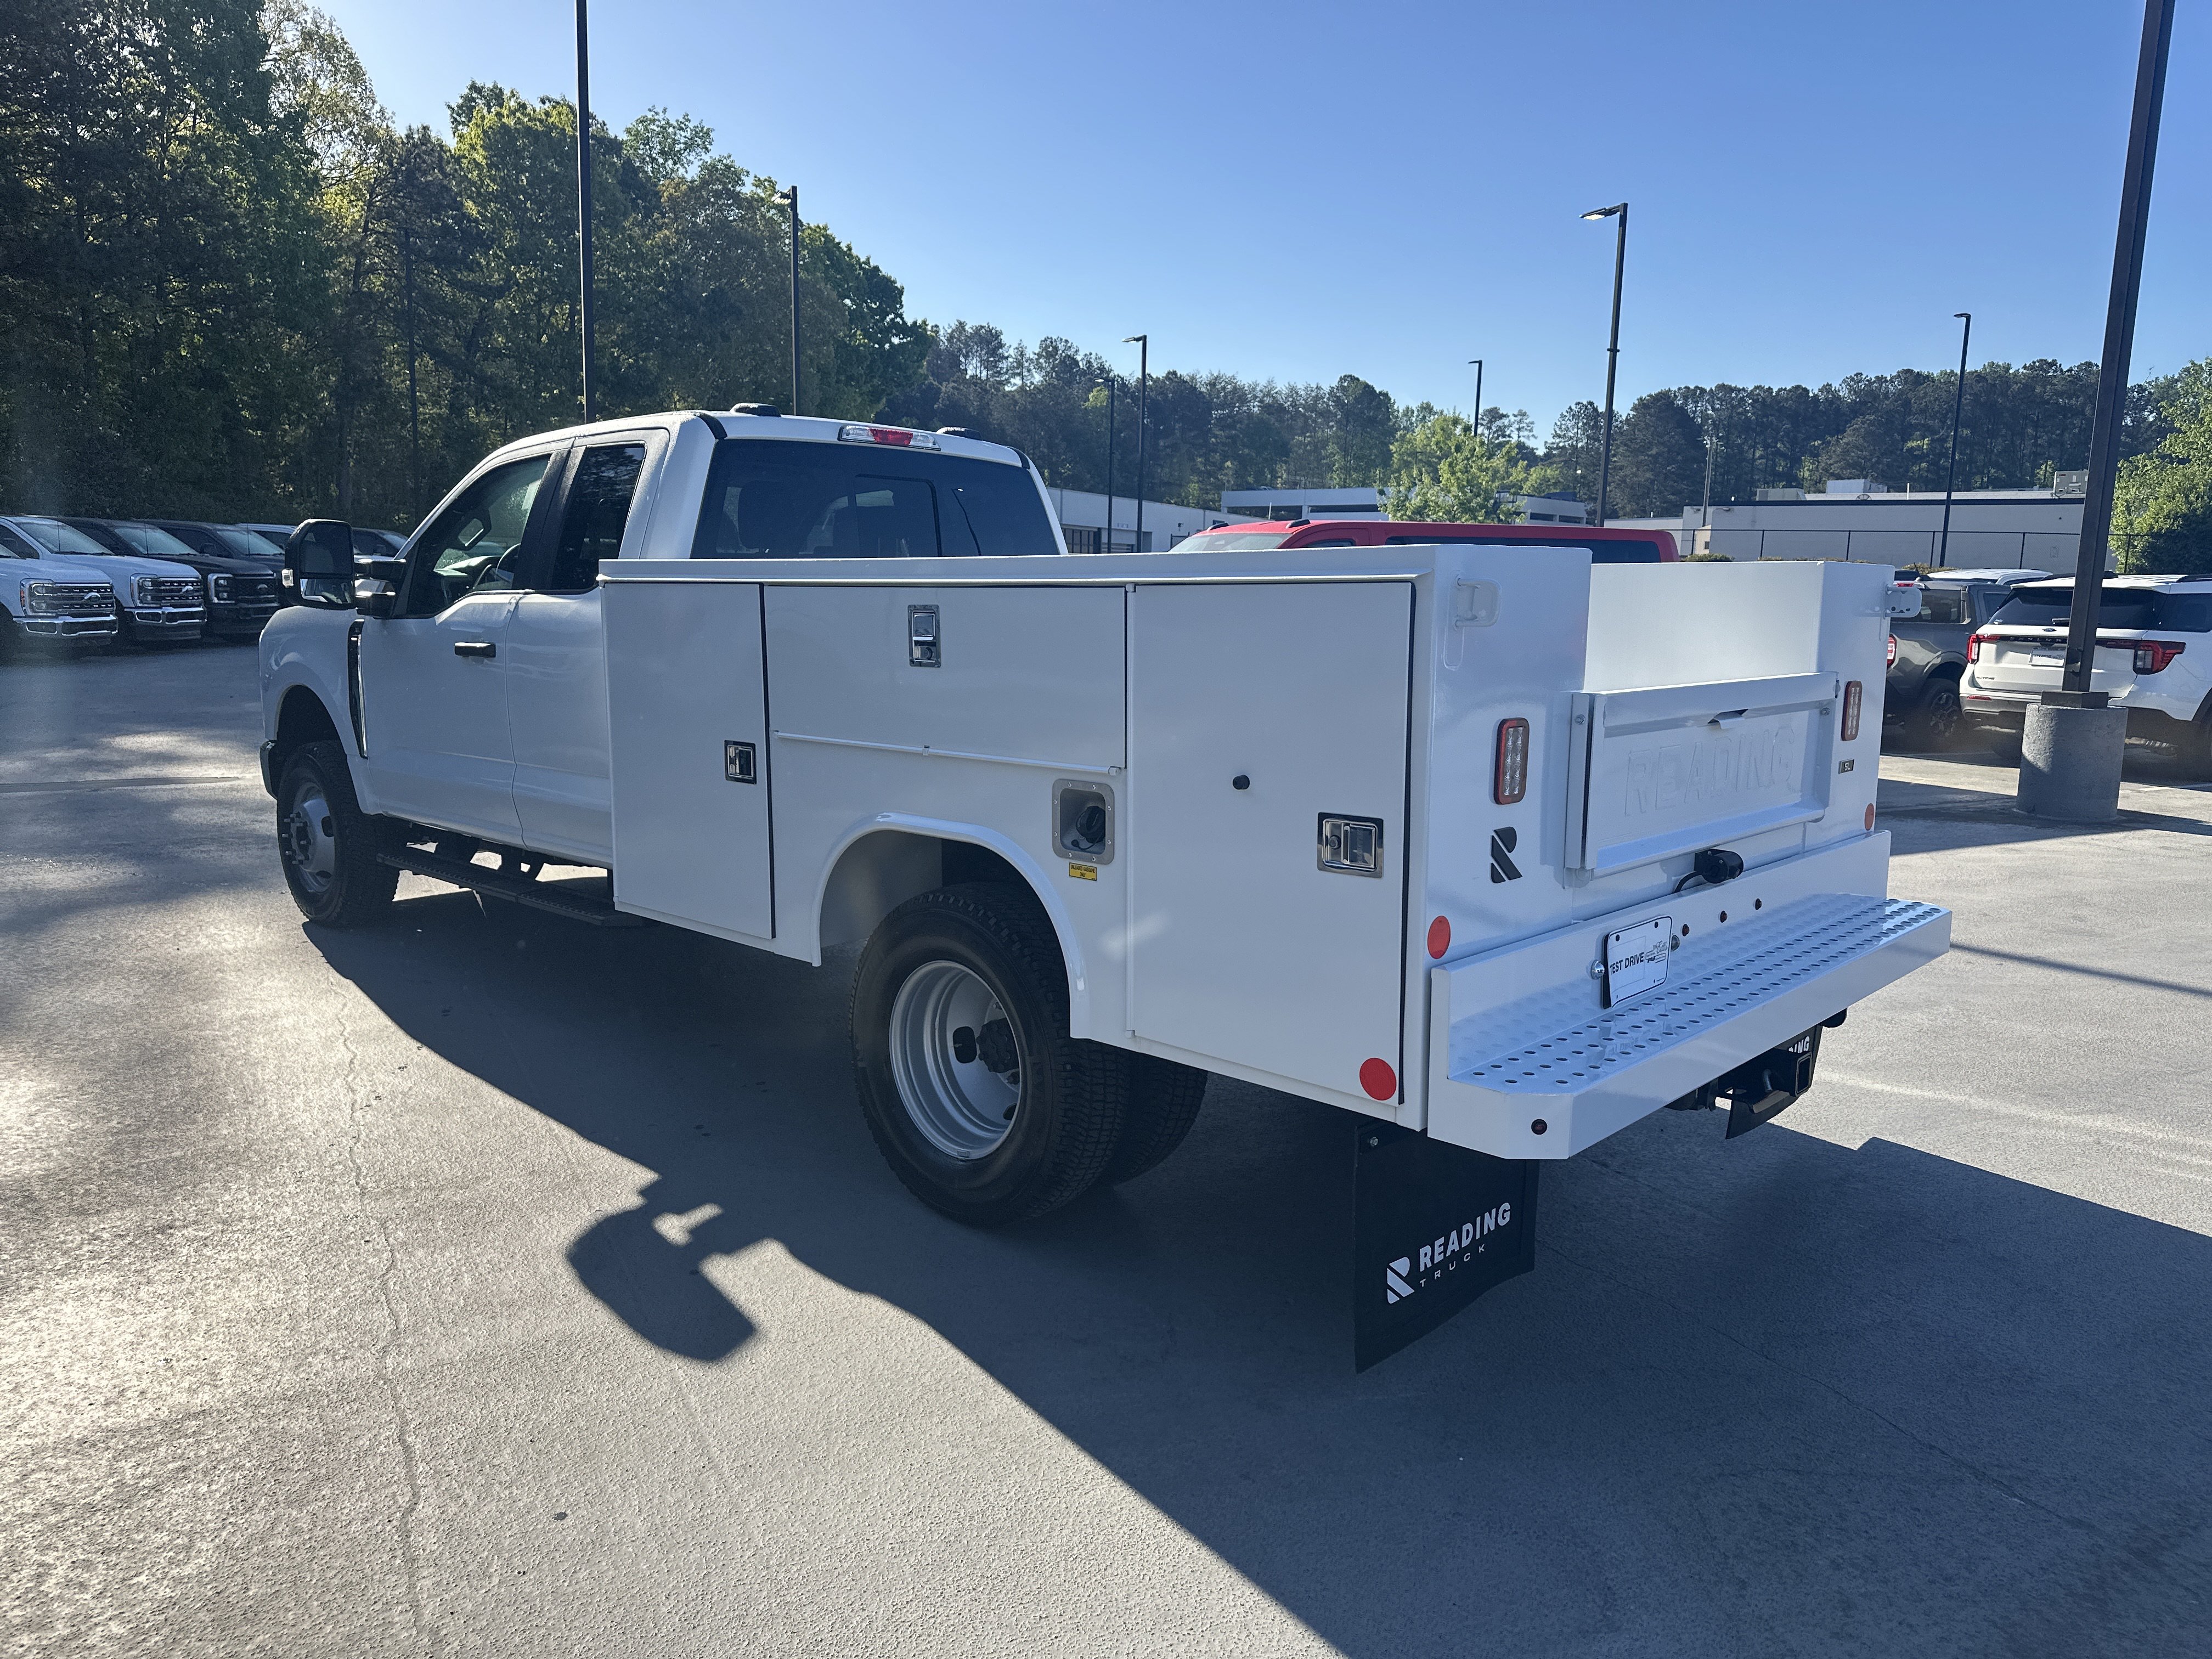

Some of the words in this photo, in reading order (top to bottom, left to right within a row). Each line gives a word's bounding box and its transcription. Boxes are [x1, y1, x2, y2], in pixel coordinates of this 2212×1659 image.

[1624, 726, 1796, 816] READING
[1610, 959, 1623, 975] TEST
[1624, 952, 1644, 969] DRIVE
[1419, 1202, 1511, 1272] READING
[1419, 1244, 1485, 1288] TRUCK
